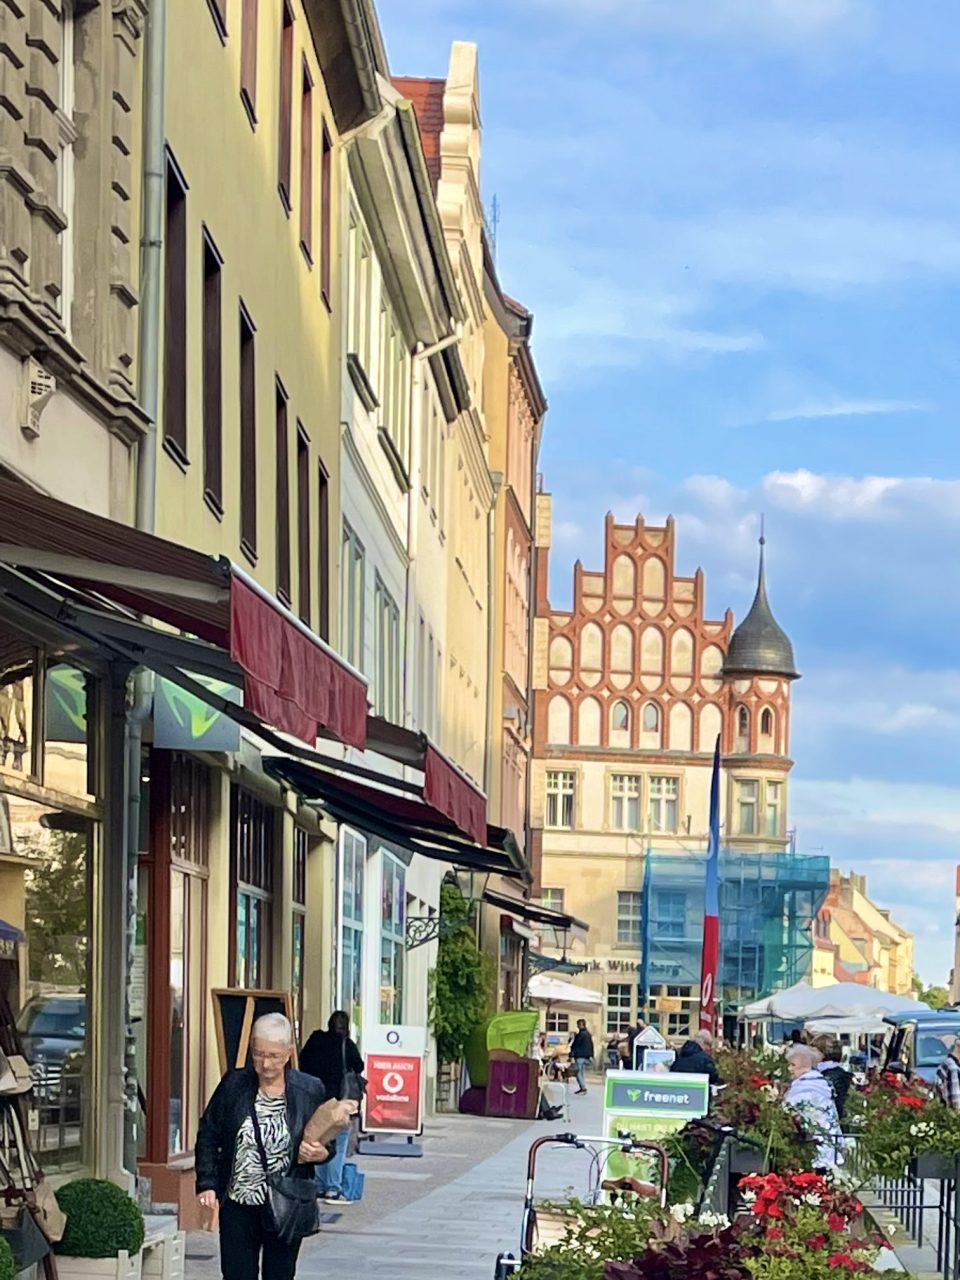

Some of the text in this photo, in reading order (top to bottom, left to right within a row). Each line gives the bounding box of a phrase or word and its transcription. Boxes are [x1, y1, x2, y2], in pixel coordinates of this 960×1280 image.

[373, 1061, 414, 1071] HIER AUCH
[375, 1094, 409, 1103] vodafone
[644, 1090, 690, 1104] freenet
